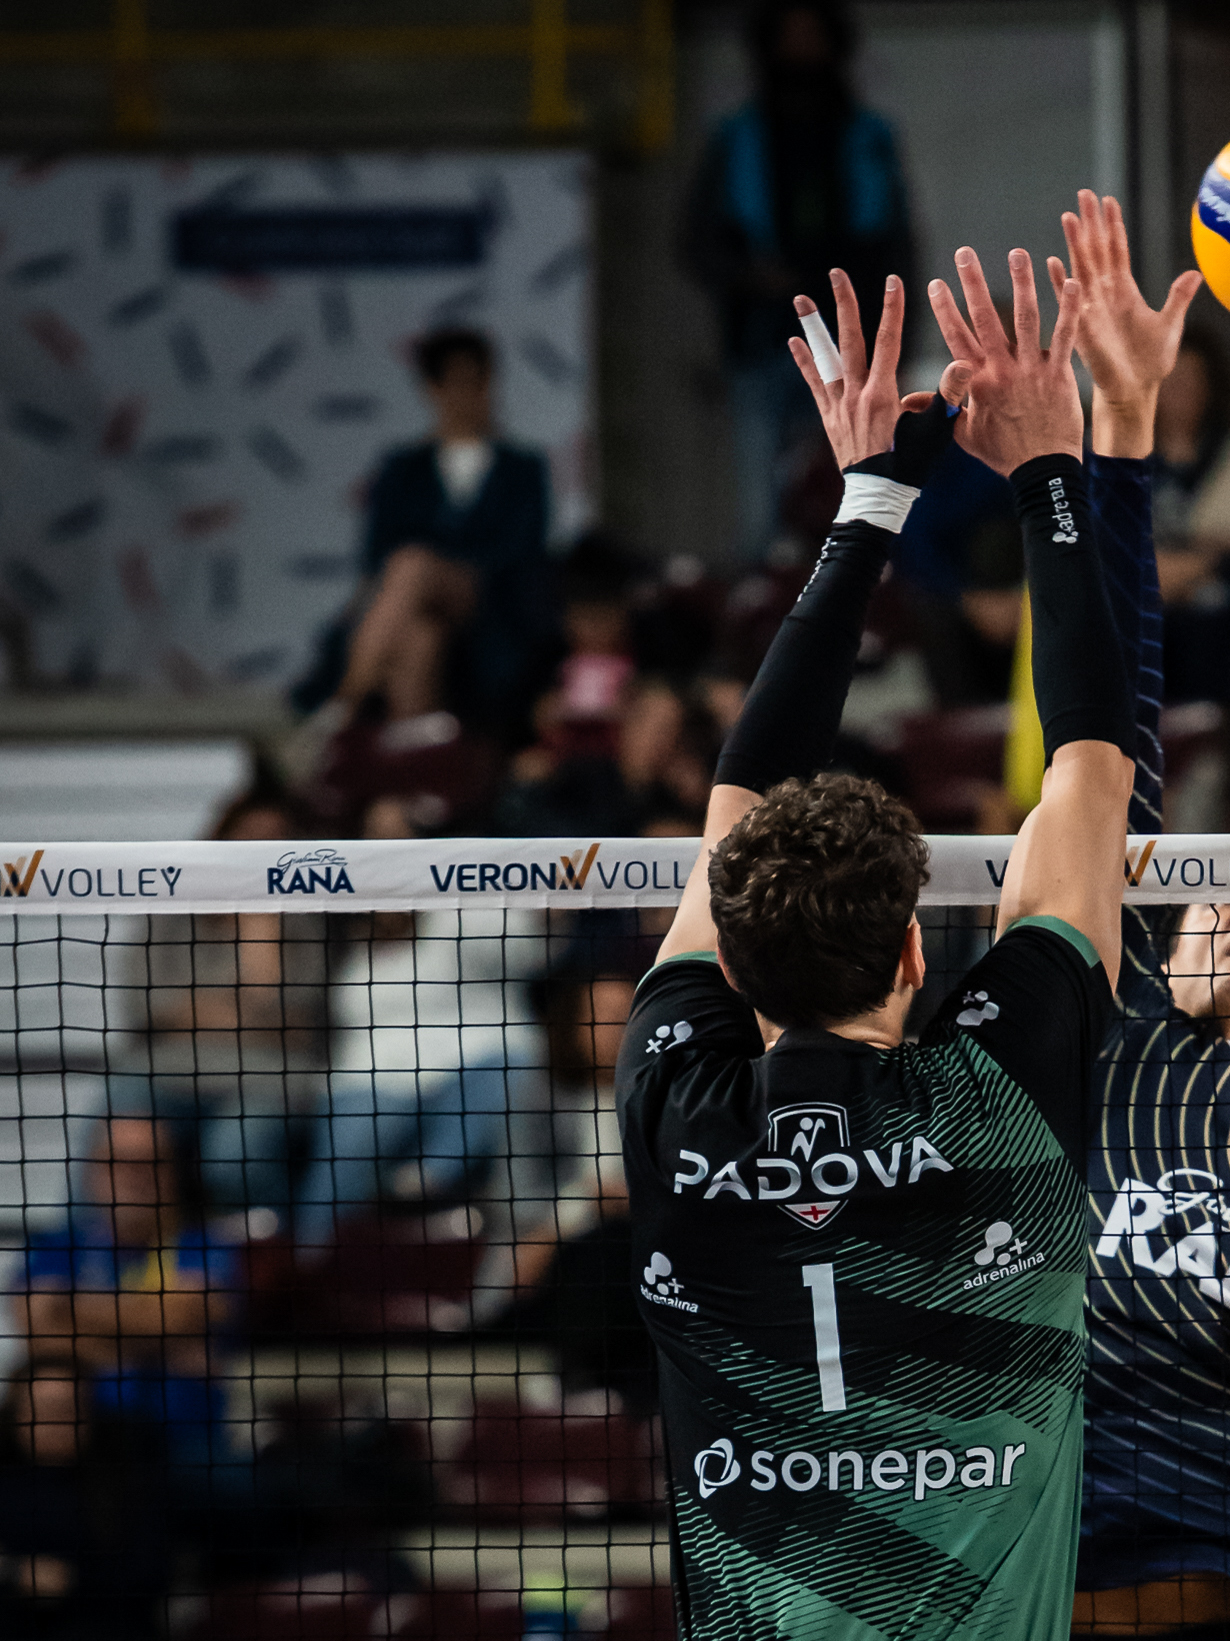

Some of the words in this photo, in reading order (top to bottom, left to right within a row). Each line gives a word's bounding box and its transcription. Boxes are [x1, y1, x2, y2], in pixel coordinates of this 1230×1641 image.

[40, 866, 182, 897] VOLLEY
[267, 867, 355, 894] RANA
[597, 861, 687, 890] VOLL
[673, 1136, 955, 1201] PADOVA
[963, 1251, 1045, 1290] adrenalina
[801, 1262, 847, 1412] 1
[750, 1442, 1026, 1500] sonepar
